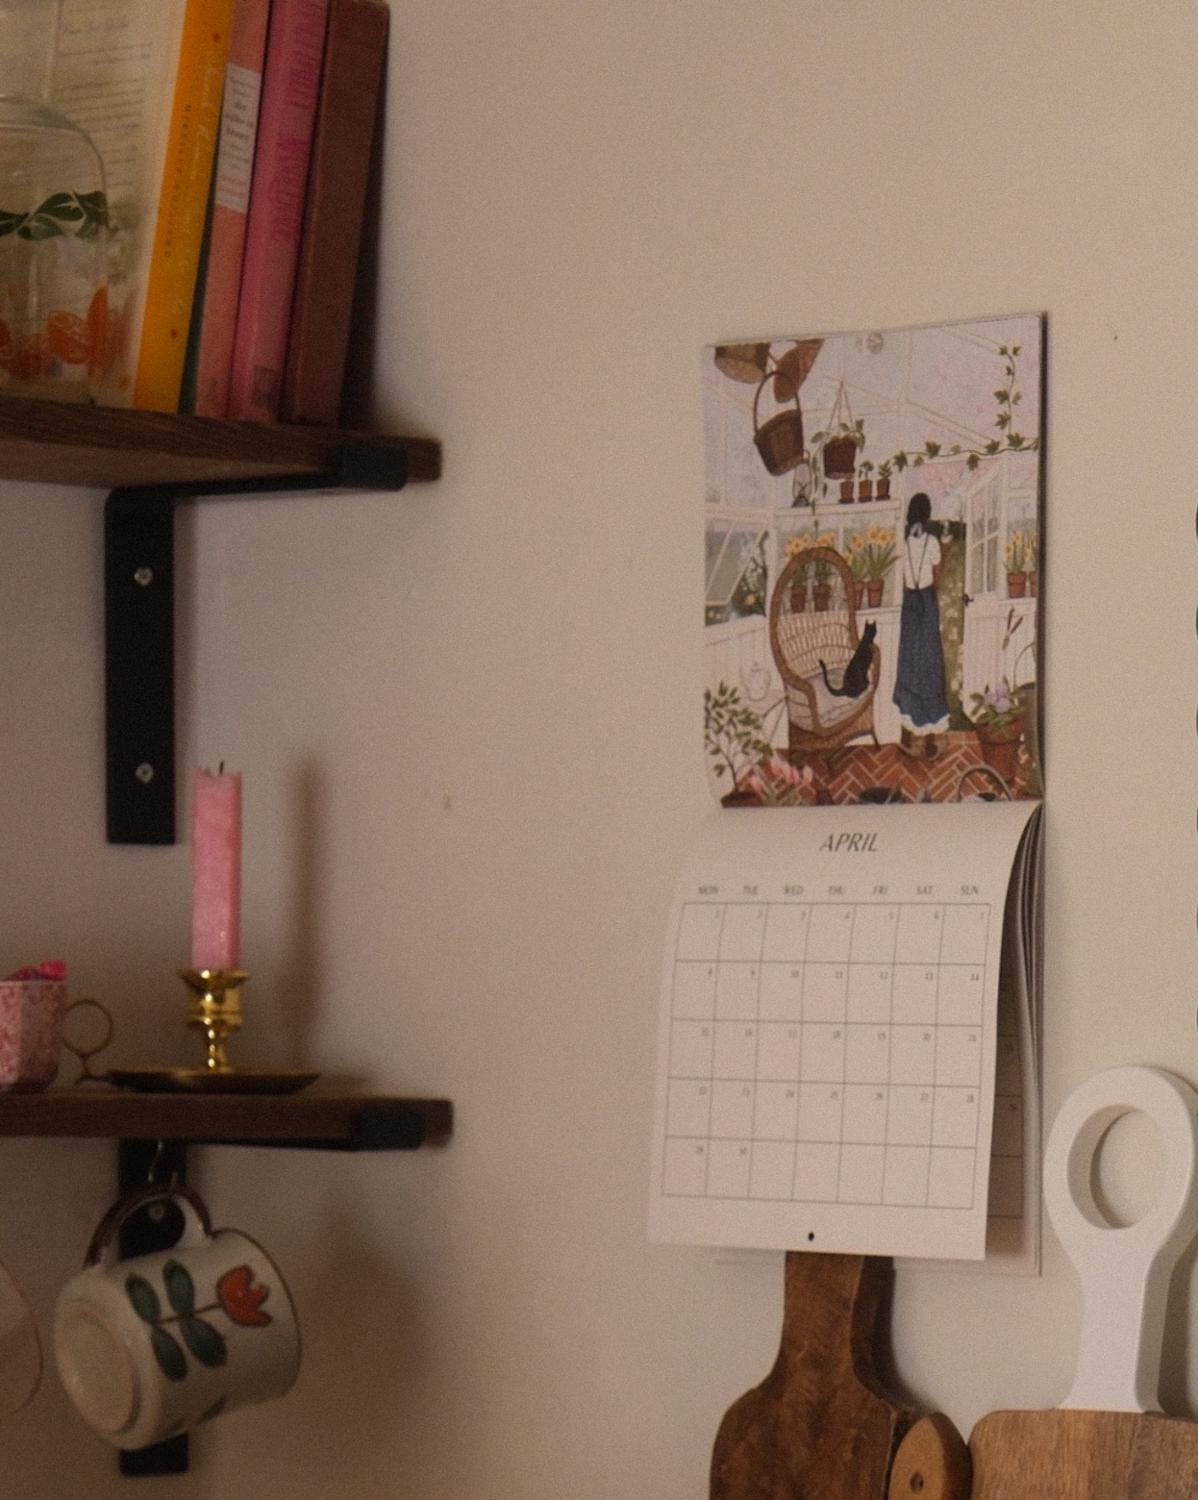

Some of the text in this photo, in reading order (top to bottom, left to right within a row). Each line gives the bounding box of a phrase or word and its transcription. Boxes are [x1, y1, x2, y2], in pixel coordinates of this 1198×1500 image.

[819, 832, 878, 852] APRIL
[698, 885, 720, 895] MON
[916, 885, 933, 895] SAT
[960, 885, 979, 896] SUN
